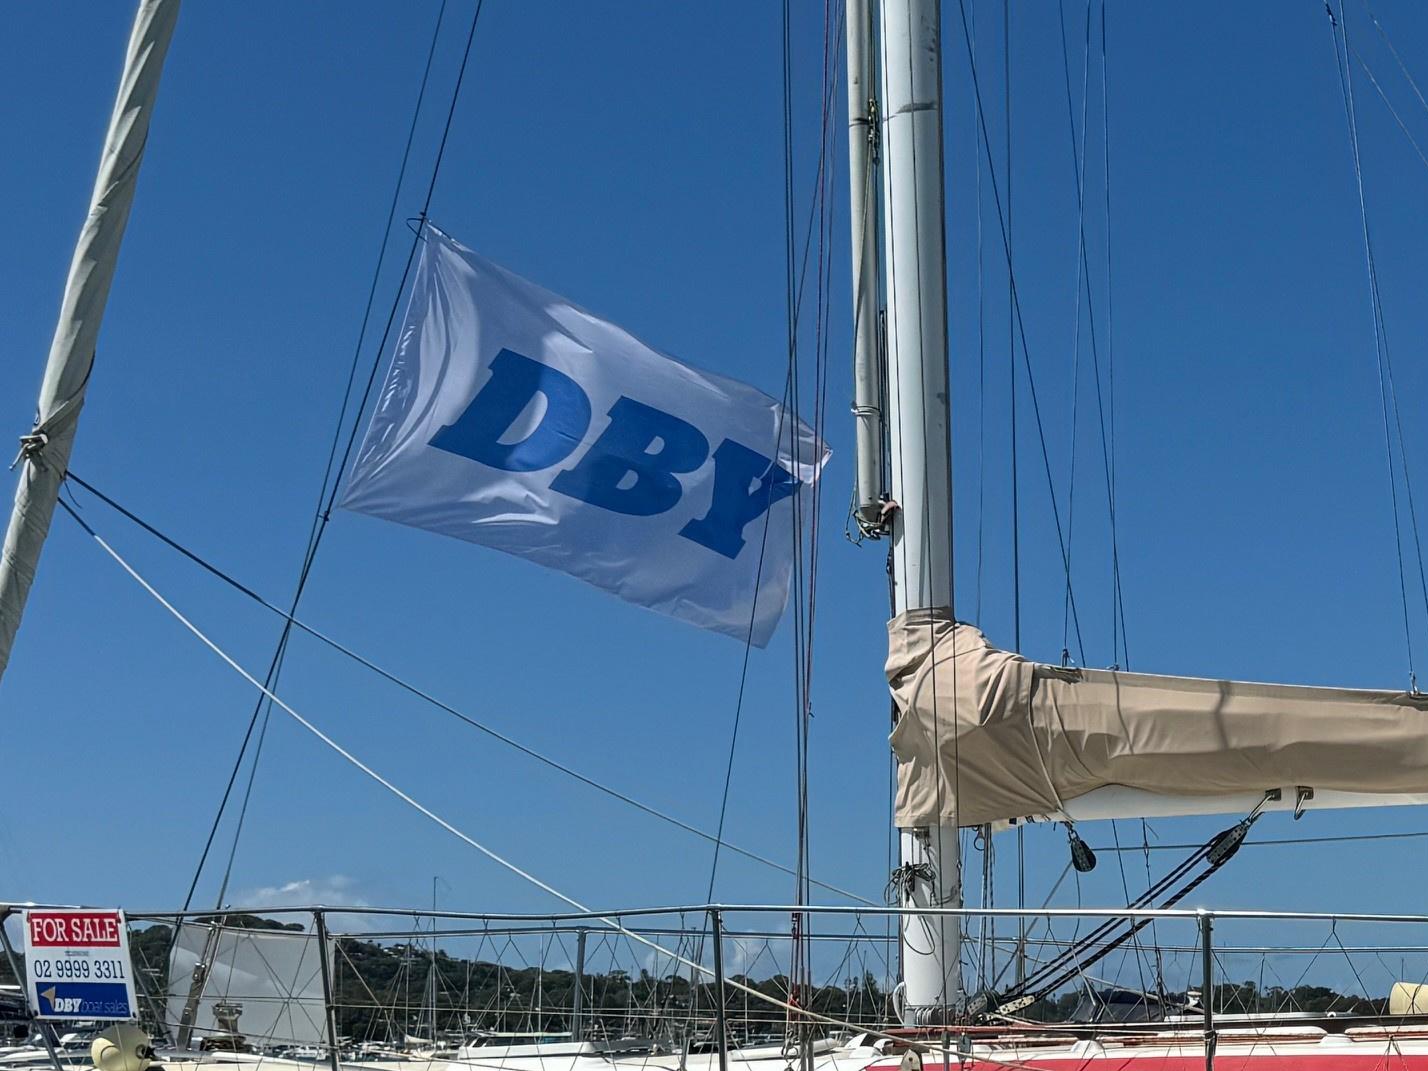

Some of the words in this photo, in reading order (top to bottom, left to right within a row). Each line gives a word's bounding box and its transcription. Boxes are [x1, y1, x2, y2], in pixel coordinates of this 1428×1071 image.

[427, 347, 802, 560] DBY
[32, 918, 70, 942] FOR
[70, 918, 118, 942] SALE
[34, 960, 52, 978] 02
[55, 960, 90, 978] 9999
[94, 960, 125, 979] 3311
[54, 998, 82, 1013] DBY
[104, 1000, 128, 1014] sales
